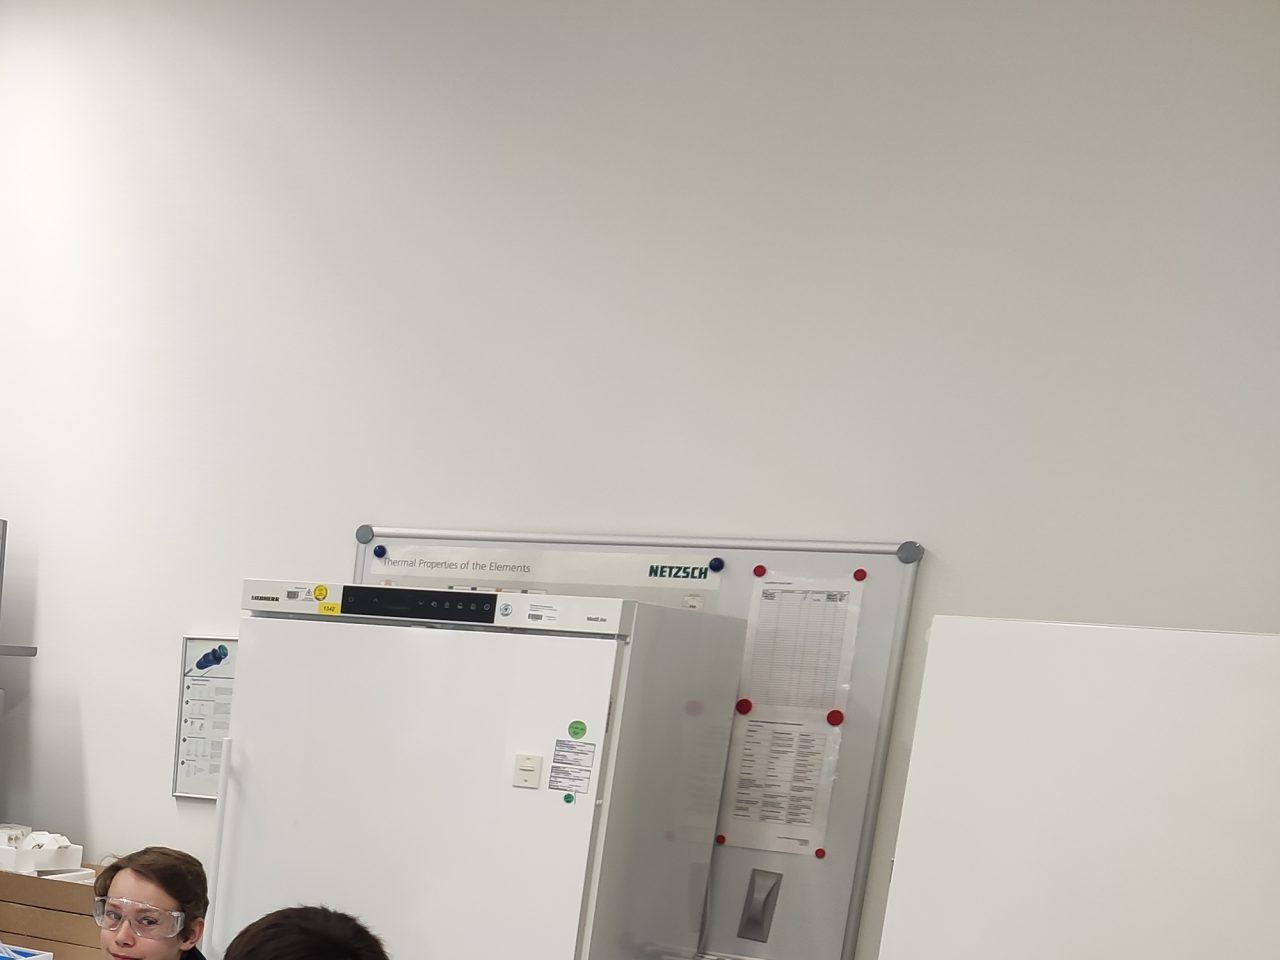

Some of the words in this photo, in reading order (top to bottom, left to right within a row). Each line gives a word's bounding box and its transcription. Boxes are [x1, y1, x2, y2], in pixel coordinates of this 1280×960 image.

[383, 557, 416, 568] Thermal
[418, 558, 458, 570] Properties
[460, 560, 470, 570] of
[472, 561, 487, 571] the
[489, 562, 531, 573] Elements
[648, 565, 708, 580] NETZSCH
